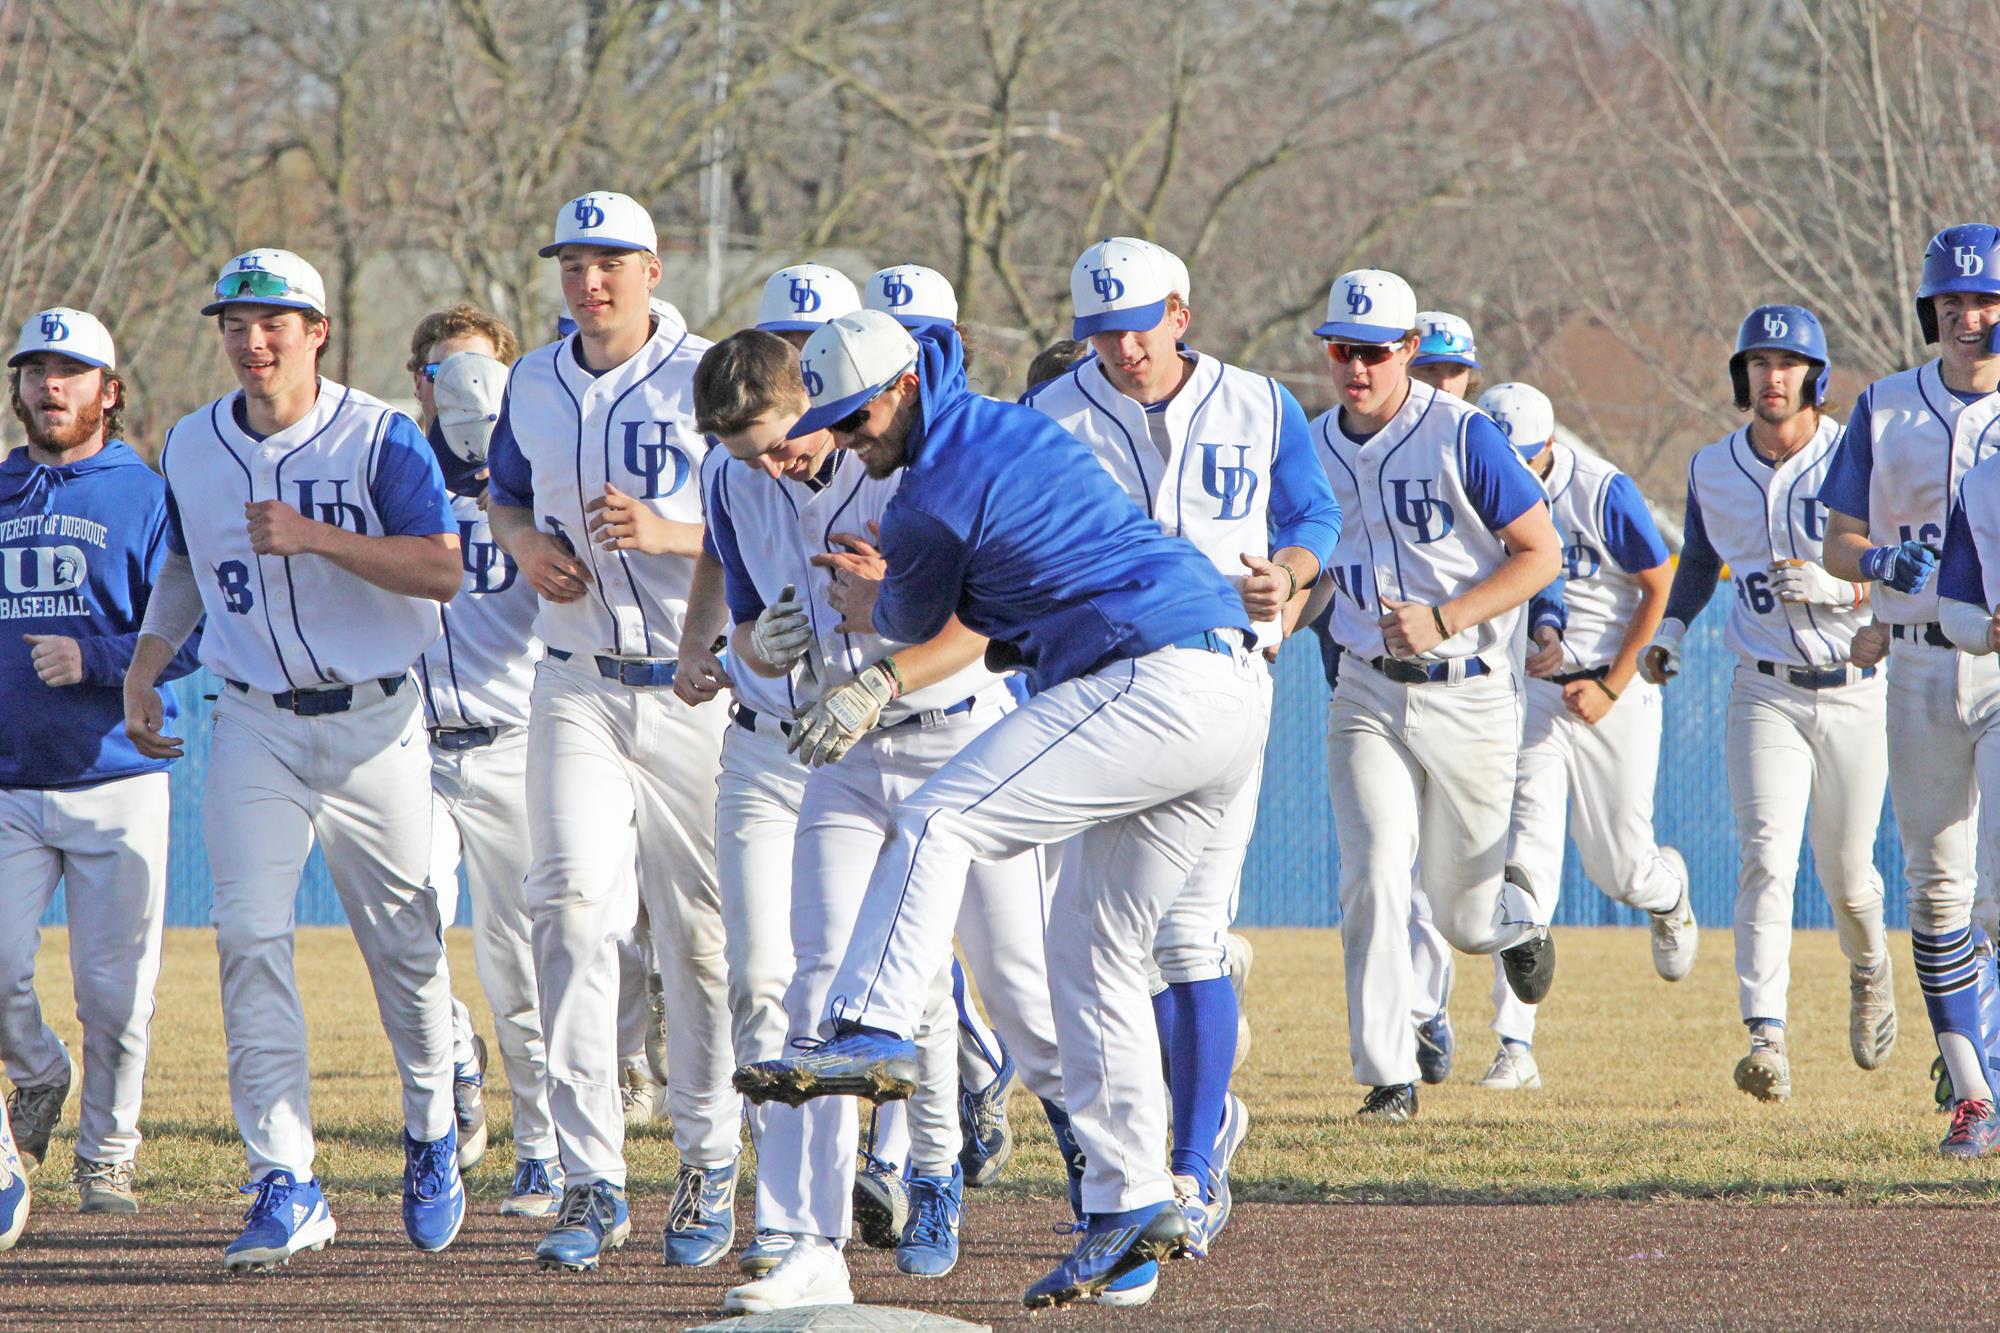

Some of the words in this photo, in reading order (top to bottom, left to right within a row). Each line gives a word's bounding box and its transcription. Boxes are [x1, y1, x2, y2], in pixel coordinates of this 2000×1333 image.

[574, 197, 605, 229] UD
[1953, 246, 1984, 277] UD
[789, 278, 821, 313] UD
[883, 264, 913, 307] UD
[1090, 267, 1125, 302] UD
[1347, 284, 1372, 315] UD
[36, 313, 69, 342] UD
[1763, 313, 1789, 339] UD
[801, 360, 824, 397] UD
[620, 421, 690, 499] UD
[1196, 443, 1258, 520] UD
[1388, 479, 1454, 543] UD
[45, 514, 60, 535] OF
[60, 515, 108, 549] DUBUQUE
[0, 545, 88, 594] UD
[0, 596, 91, 620] BASEBALL
